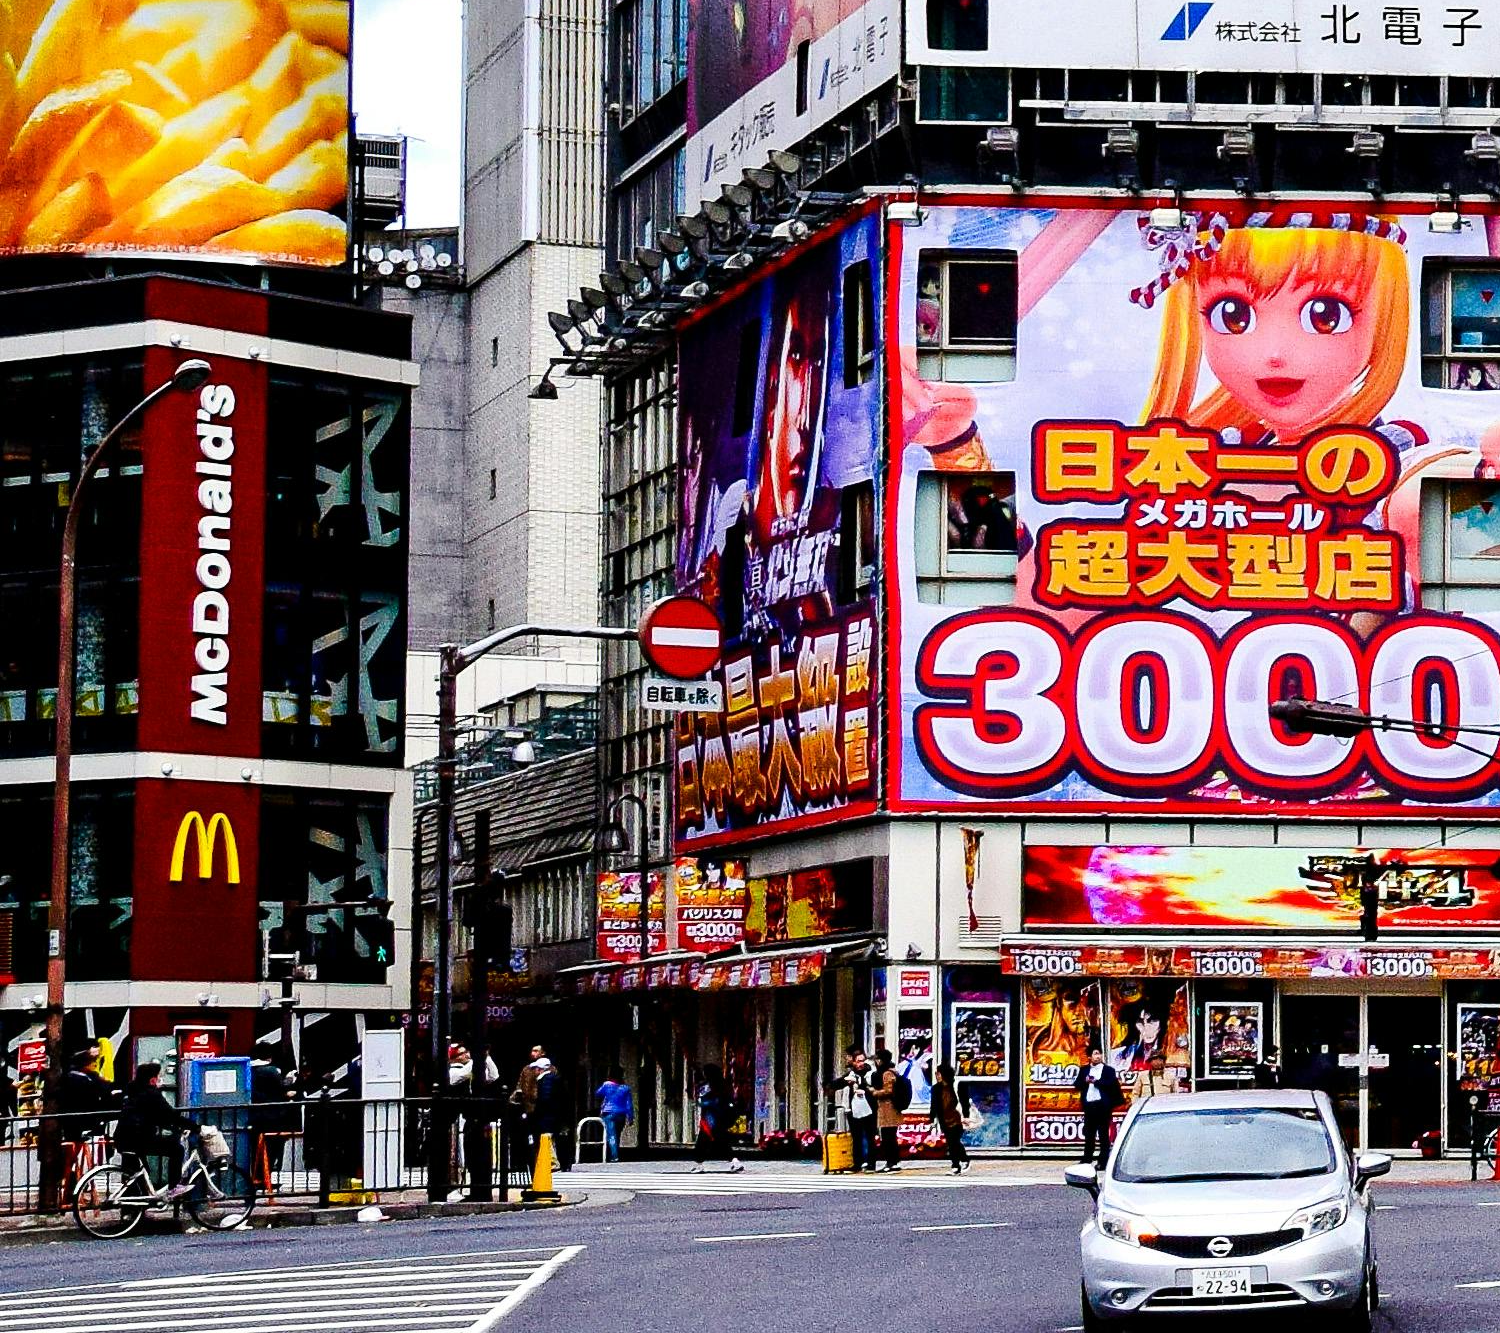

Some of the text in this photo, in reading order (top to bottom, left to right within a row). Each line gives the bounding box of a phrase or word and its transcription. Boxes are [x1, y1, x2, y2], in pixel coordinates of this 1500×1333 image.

[1215, 4, 1483, 47] 株式会社 北電子
[1045, 429, 1386, 496] 日本一の
[1135, 499, 1325, 531] メガホール
[189, 382, 236, 727] McDonald's
[1048, 529, 1393, 601] 超大型店
[647, 683, 717, 707] 自転車を除く
